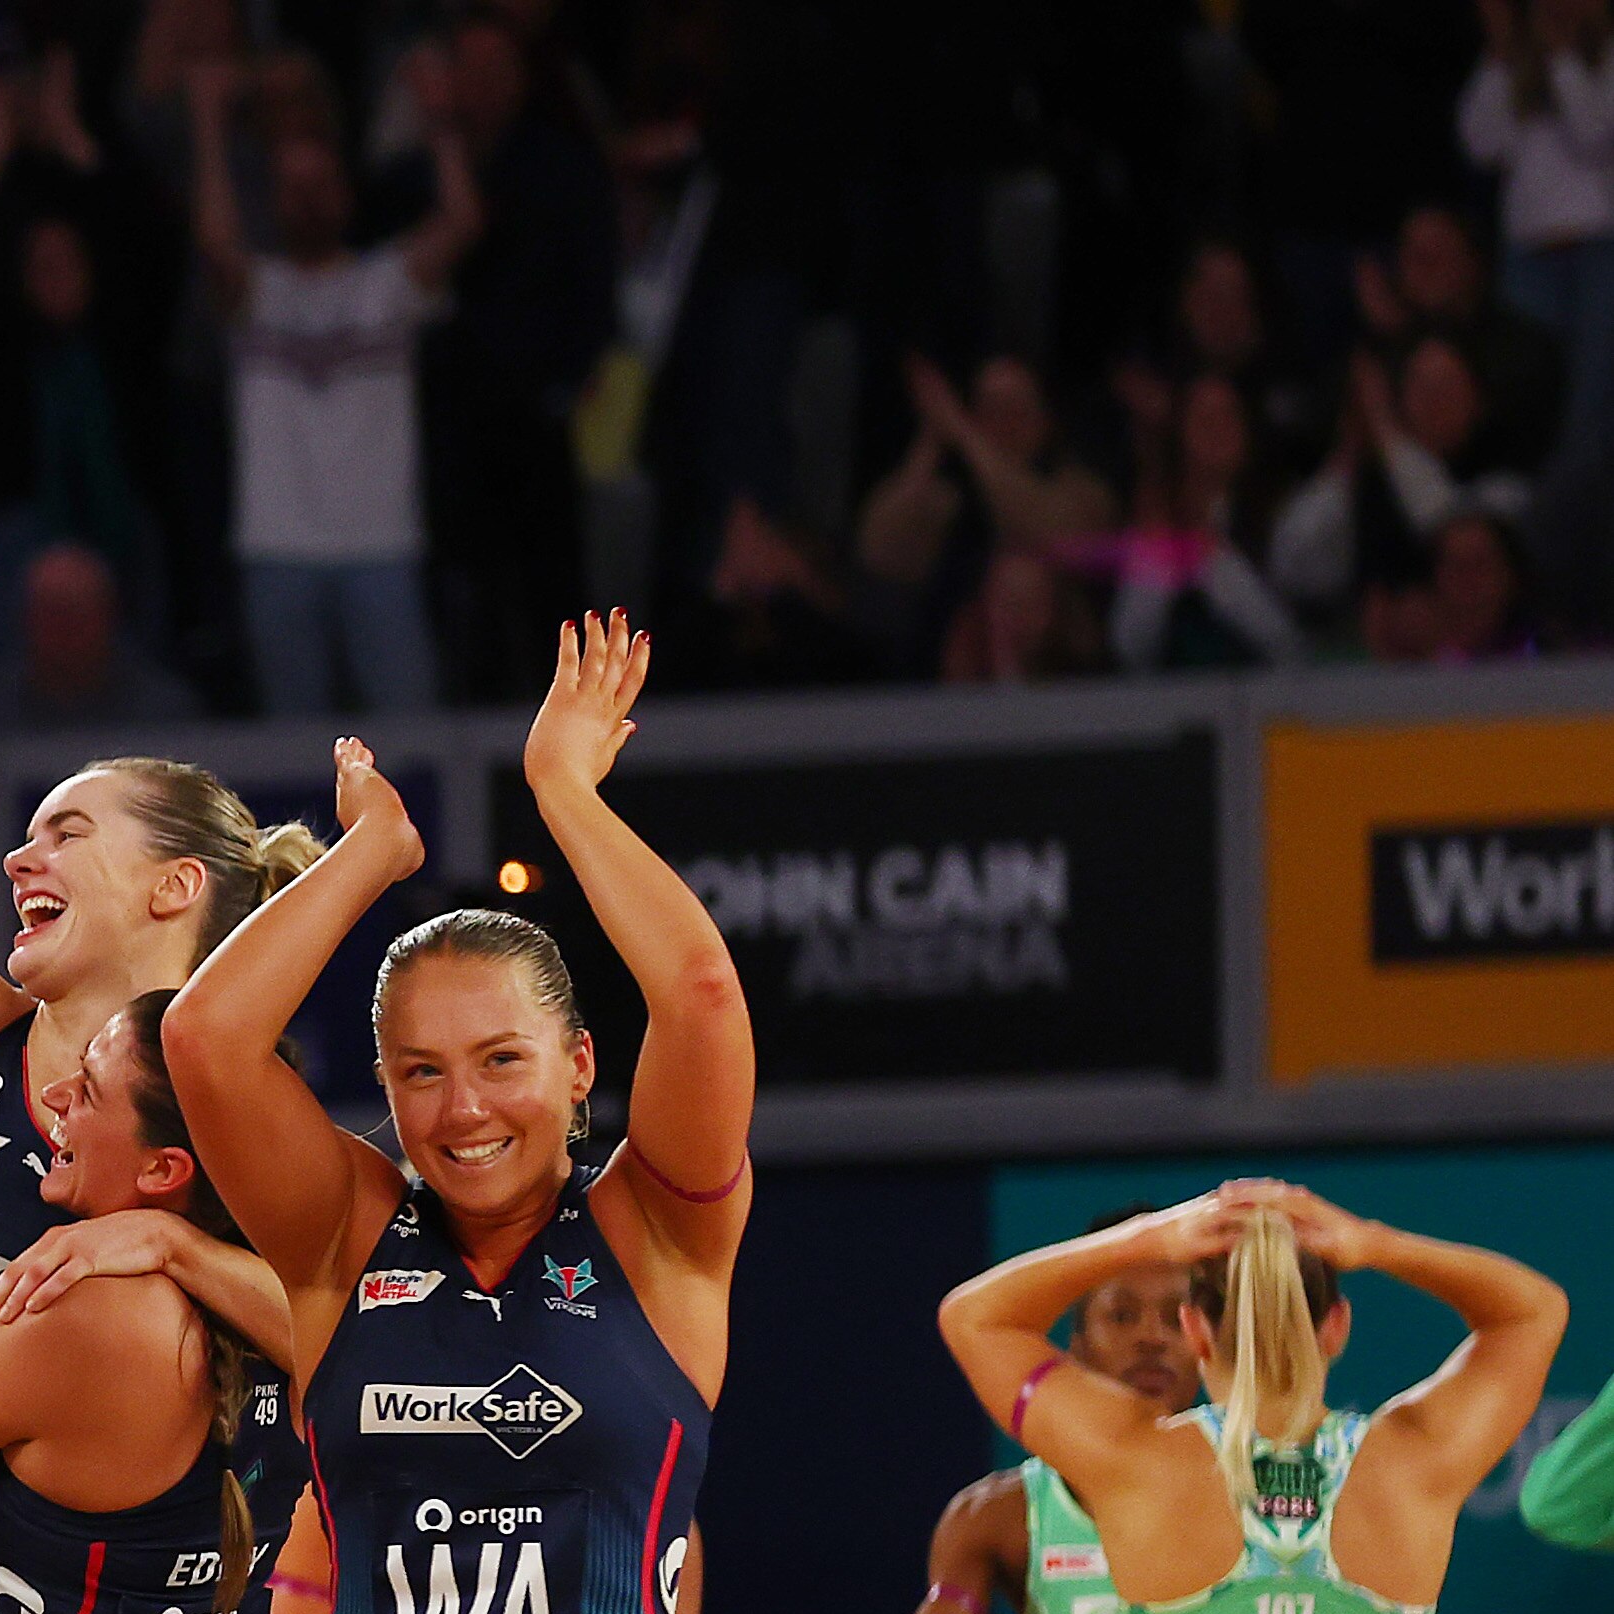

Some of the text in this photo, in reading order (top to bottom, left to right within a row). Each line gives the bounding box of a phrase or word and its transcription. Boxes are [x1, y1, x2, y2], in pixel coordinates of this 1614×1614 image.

[255, 1383, 279, 1398] PKNC
[254, 1397, 278, 1426] 49
[459, 1506, 543, 1535] origin
[166, 1543, 270, 1588] EDY
